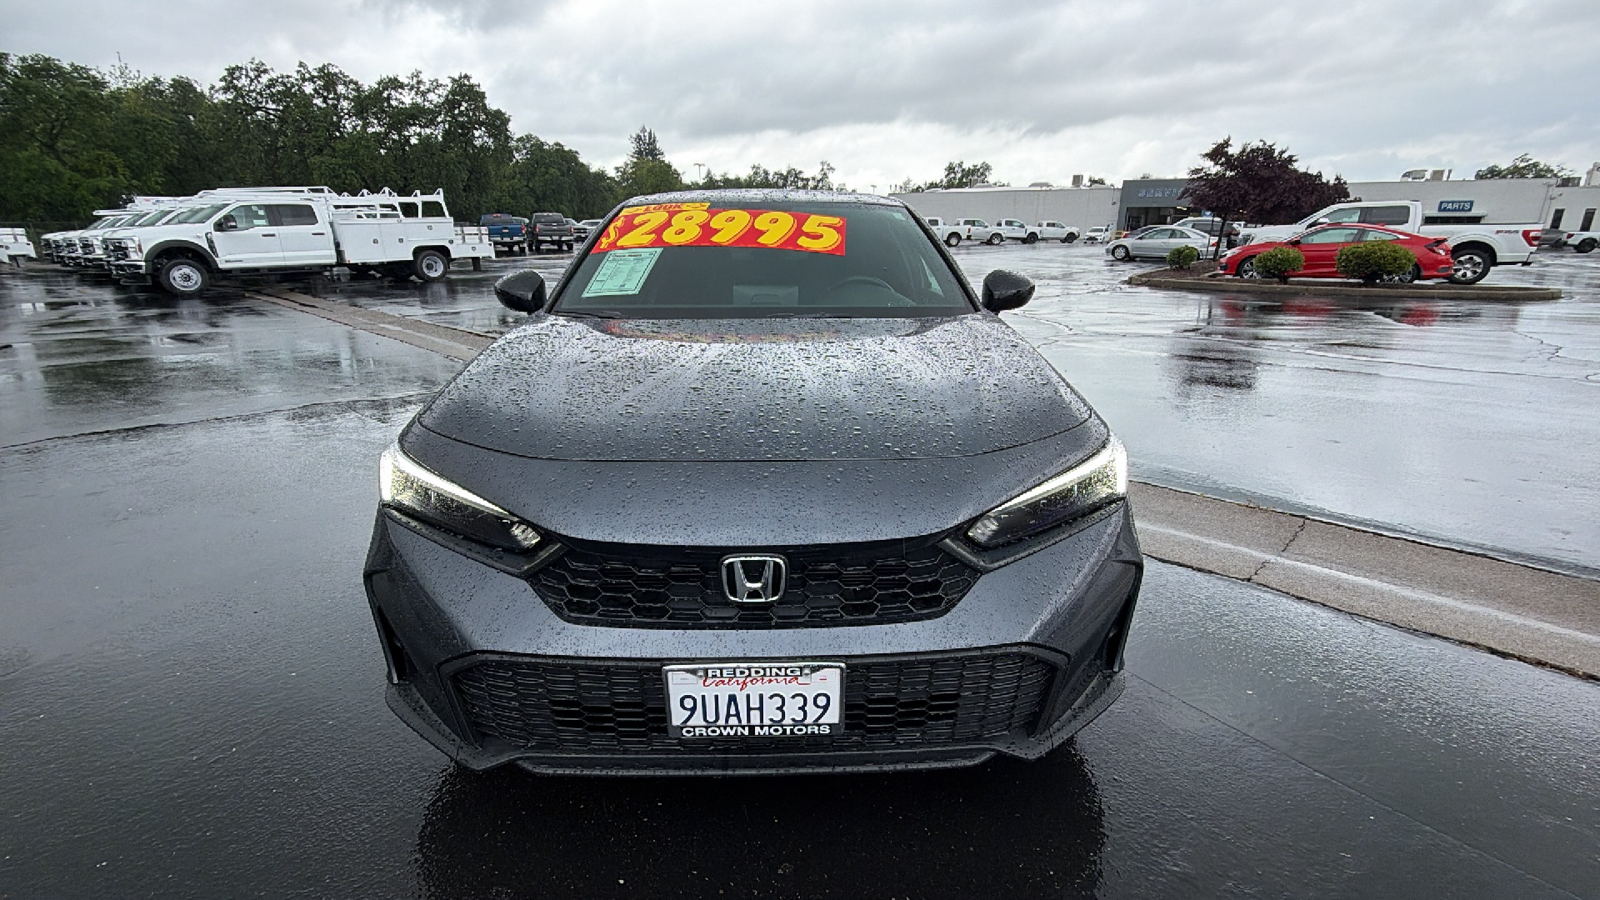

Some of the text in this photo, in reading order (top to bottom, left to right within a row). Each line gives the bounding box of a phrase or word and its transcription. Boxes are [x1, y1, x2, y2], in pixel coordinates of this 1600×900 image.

[1138, 188, 1185, 197] SERVIC
[1441, 202, 1471, 210] PARTS
[599, 209, 843, 250] $28995
[707, 668, 800, 678] REDDING
[702, 676, 810, 691] California
[679, 693, 831, 724] 9UAH339
[681, 725, 831, 737] CROWN MOTORS
